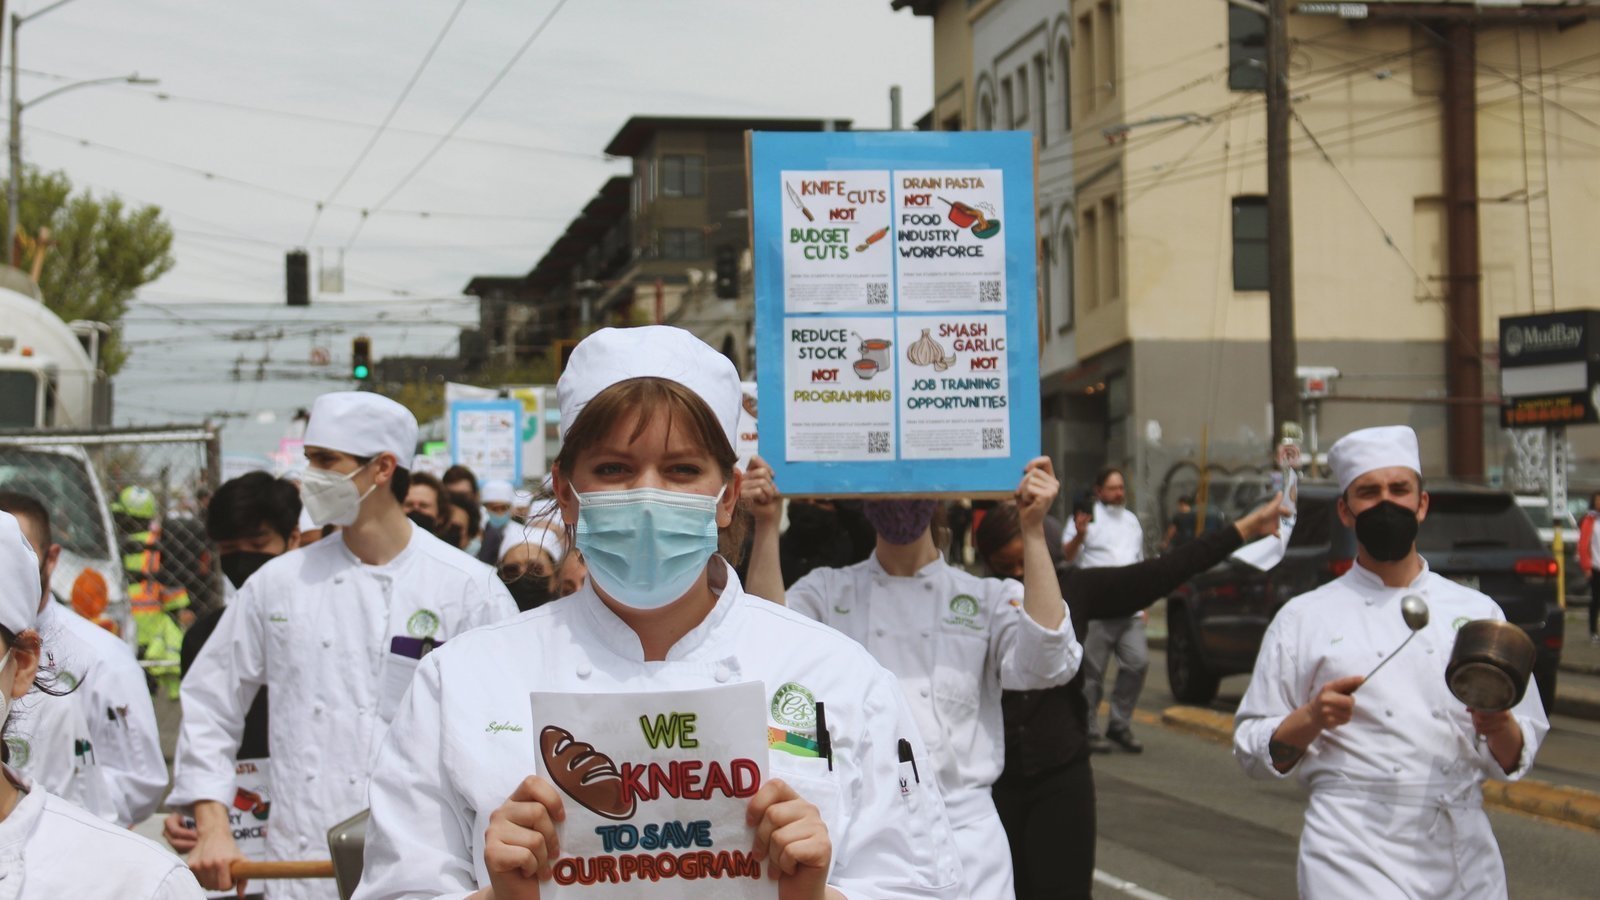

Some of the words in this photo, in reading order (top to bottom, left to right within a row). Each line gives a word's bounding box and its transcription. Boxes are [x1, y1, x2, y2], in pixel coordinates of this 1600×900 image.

[903, 178, 942, 189] DRAIN
[945, 177, 985, 189] PASTA
[801, 180, 846, 196] KNIFE
[847, 190, 886, 204] CUTS
[904, 194, 932, 206] NOT
[829, 208, 857, 220] NOT
[902, 214, 941, 226] FOOD
[790, 228, 850, 243] BUDGET
[898, 229, 959, 242] INDUSTRY
[803, 245, 849, 260] CUTS
[899, 245, 984, 258] WORKFORCE
[791, 329, 847, 343] REDUCE
[939, 323, 988, 337] SMASH
[953, 338, 1005, 352] GARLIC
[798, 347, 847, 360] STOCK
[970, 357, 999, 370] NOT
[811, 368, 839, 382] NOT
[912, 379, 937, 391] JOB
[940, 378, 1000, 391] TRAINING
[793, 389, 892, 403] PROGRAMMING
[907, 395, 1007, 410] OPPORTUNITIES
[639, 711, 699, 749] WE
[619, 758, 761, 804] KNEAD
[595, 823, 639, 852] TO
[639, 819, 713, 850] SAVE
[552, 855, 619, 886] OUR
[618, 849, 761, 882] PROGRAM
